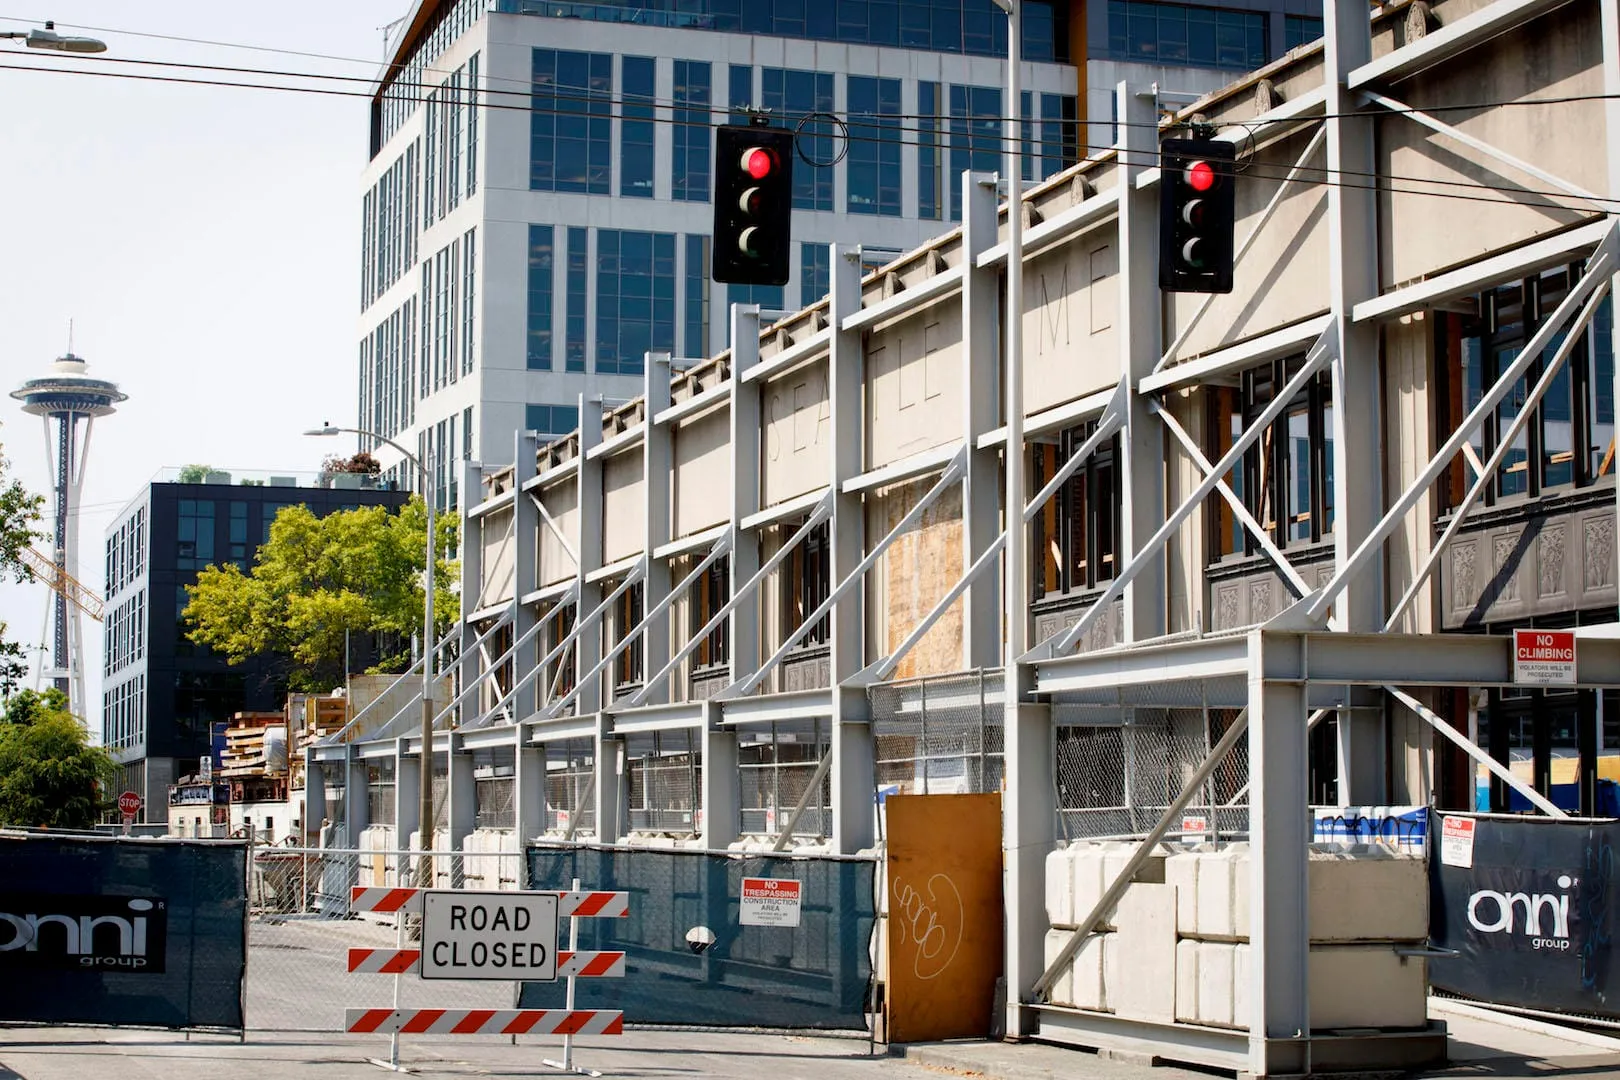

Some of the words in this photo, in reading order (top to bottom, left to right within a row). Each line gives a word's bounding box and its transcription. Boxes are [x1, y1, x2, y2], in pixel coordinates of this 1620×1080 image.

[1536, 634, 1554, 646] NO
[1518, 647, 1573, 660] CLIMBING
[120, 797, 140, 809] STOP
[764, 881, 779, 889] NO
[744, 889, 798, 898] TRESPASSING
[743, 897, 798, 906] CONSTRUCTION
[1467, 875, 1571, 938] onni
[450, 905, 531, 931] ROAD
[1532, 938, 1570, 951] group
[432, 941, 546, 968] CLOSED
[79, 956, 148, 968] group
